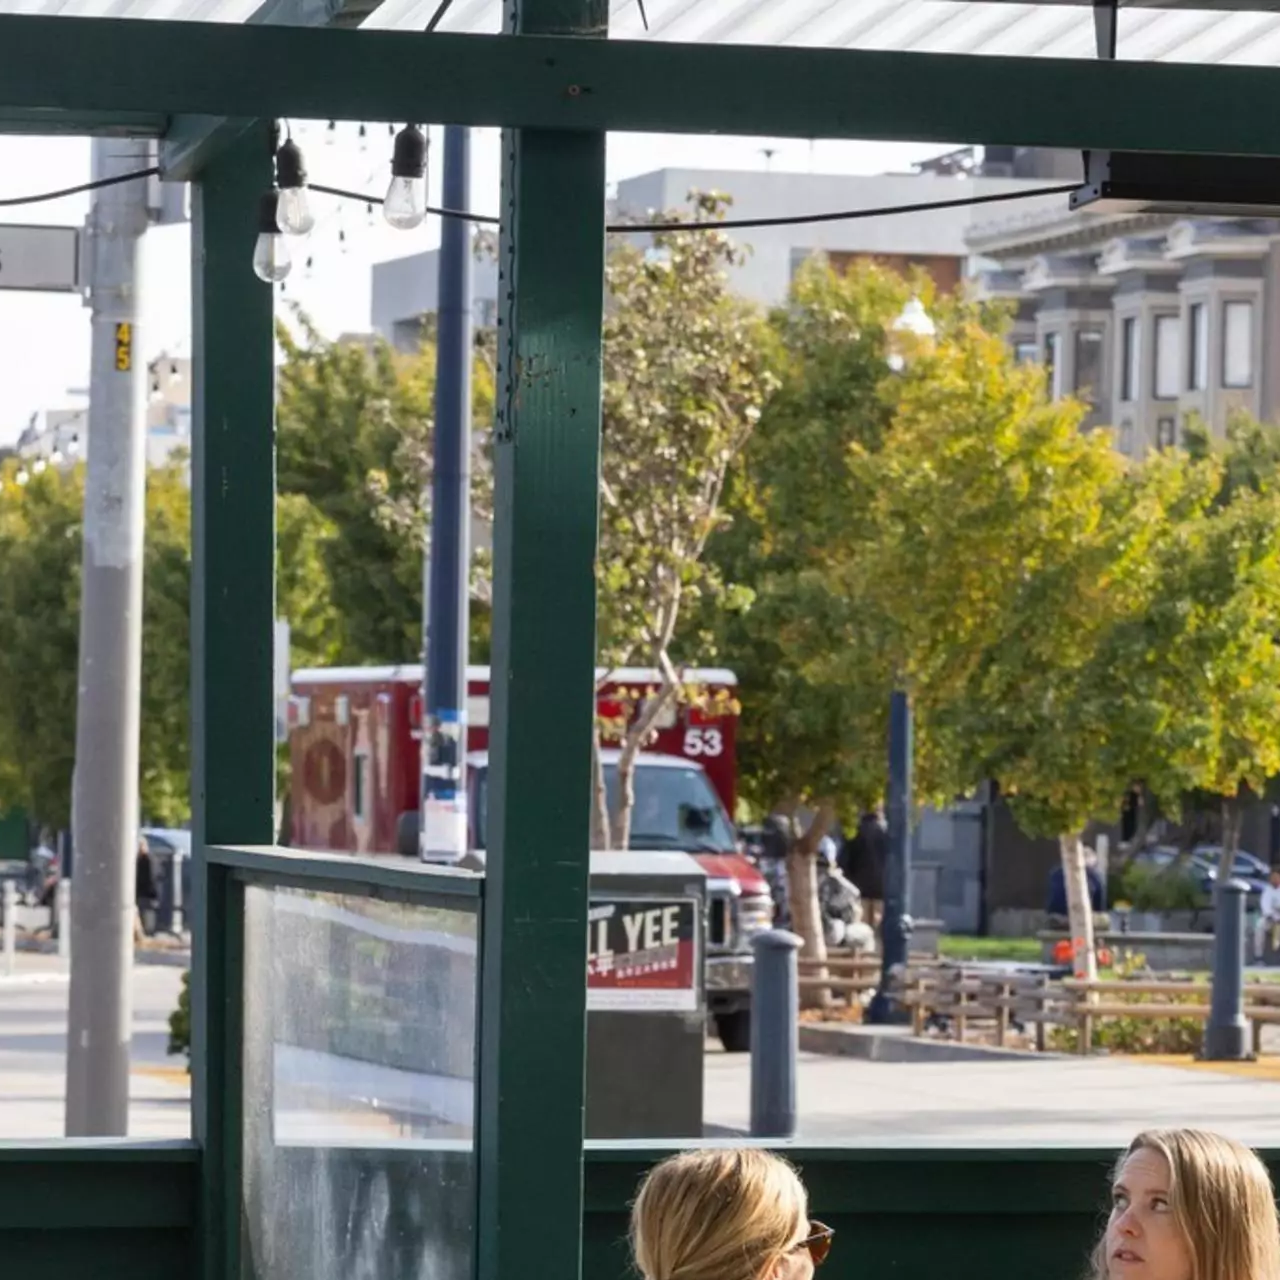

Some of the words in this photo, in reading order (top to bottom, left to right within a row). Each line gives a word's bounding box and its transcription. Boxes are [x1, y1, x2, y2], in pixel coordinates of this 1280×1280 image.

[116, 322, 131, 370] 45
[683, 727, 723, 757] 53
[622, 905, 680, 953] YEE
